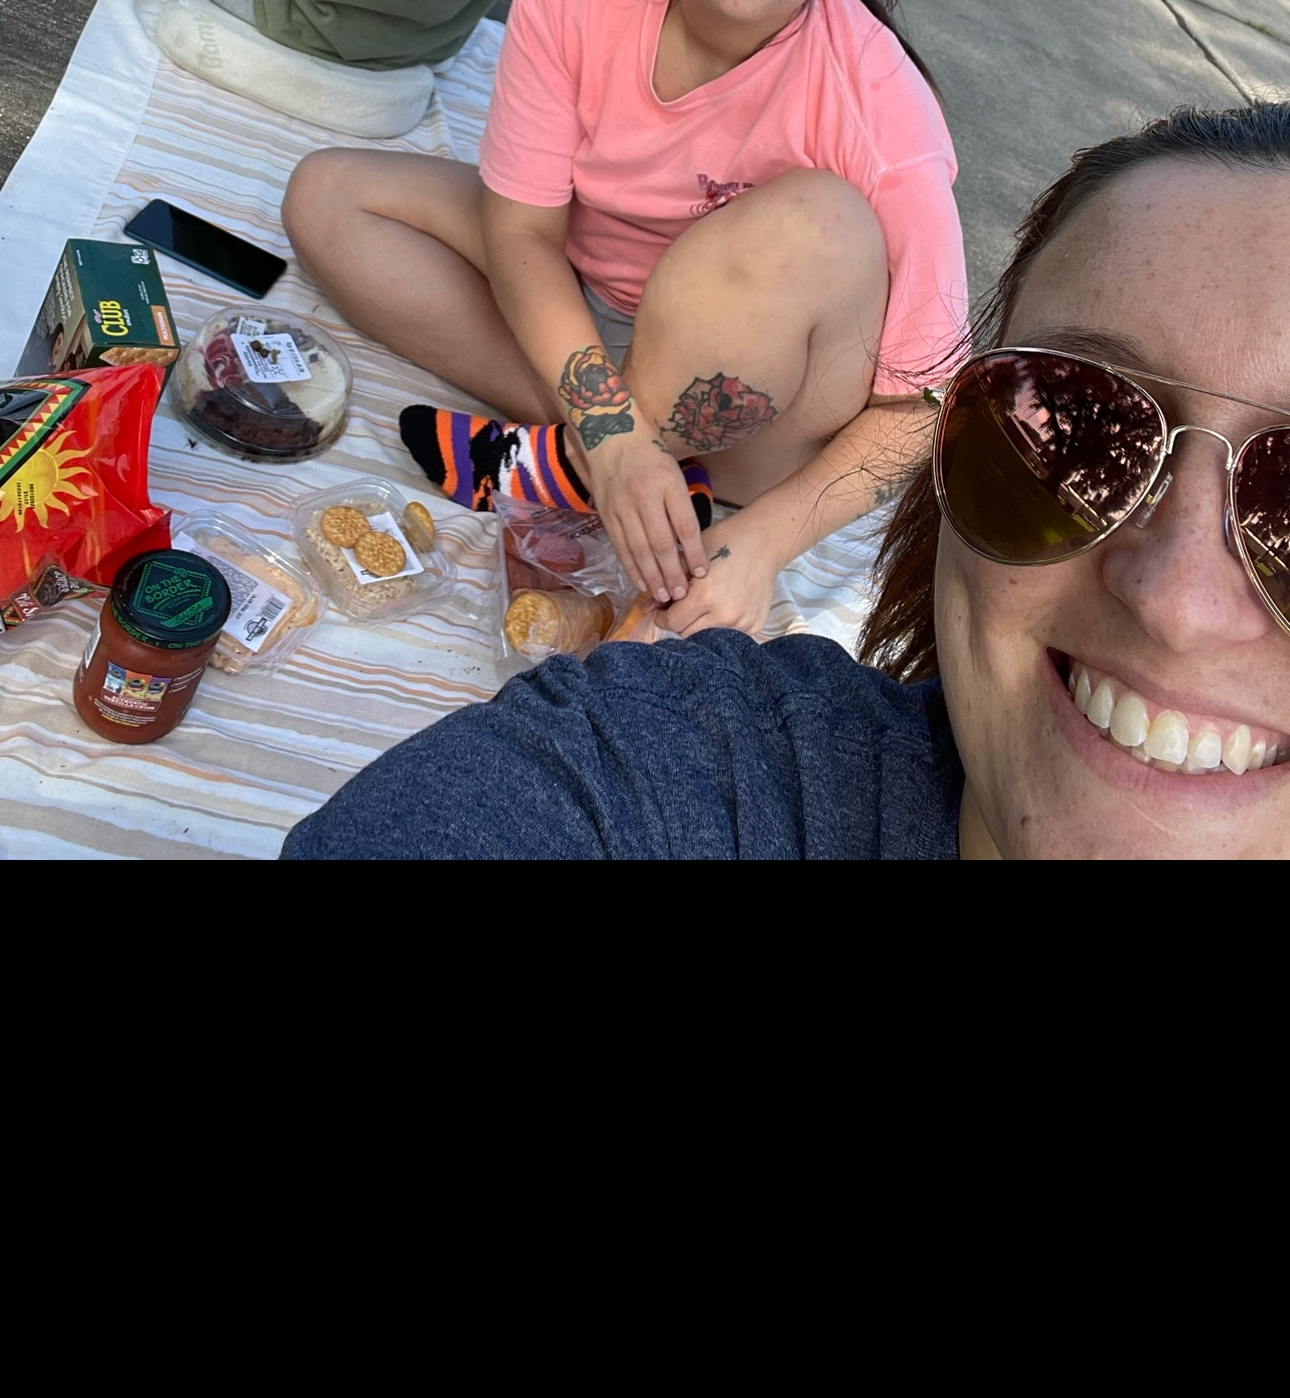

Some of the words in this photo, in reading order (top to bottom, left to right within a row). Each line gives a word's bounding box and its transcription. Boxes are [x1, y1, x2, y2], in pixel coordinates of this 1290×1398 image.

[98, 299, 130, 337] CLUB
[144, 582, 161, 594] ON
[160, 574, 182, 588] THE
[144, 578, 196, 604] BORDER
[175, 603, 204, 623] SALSA
